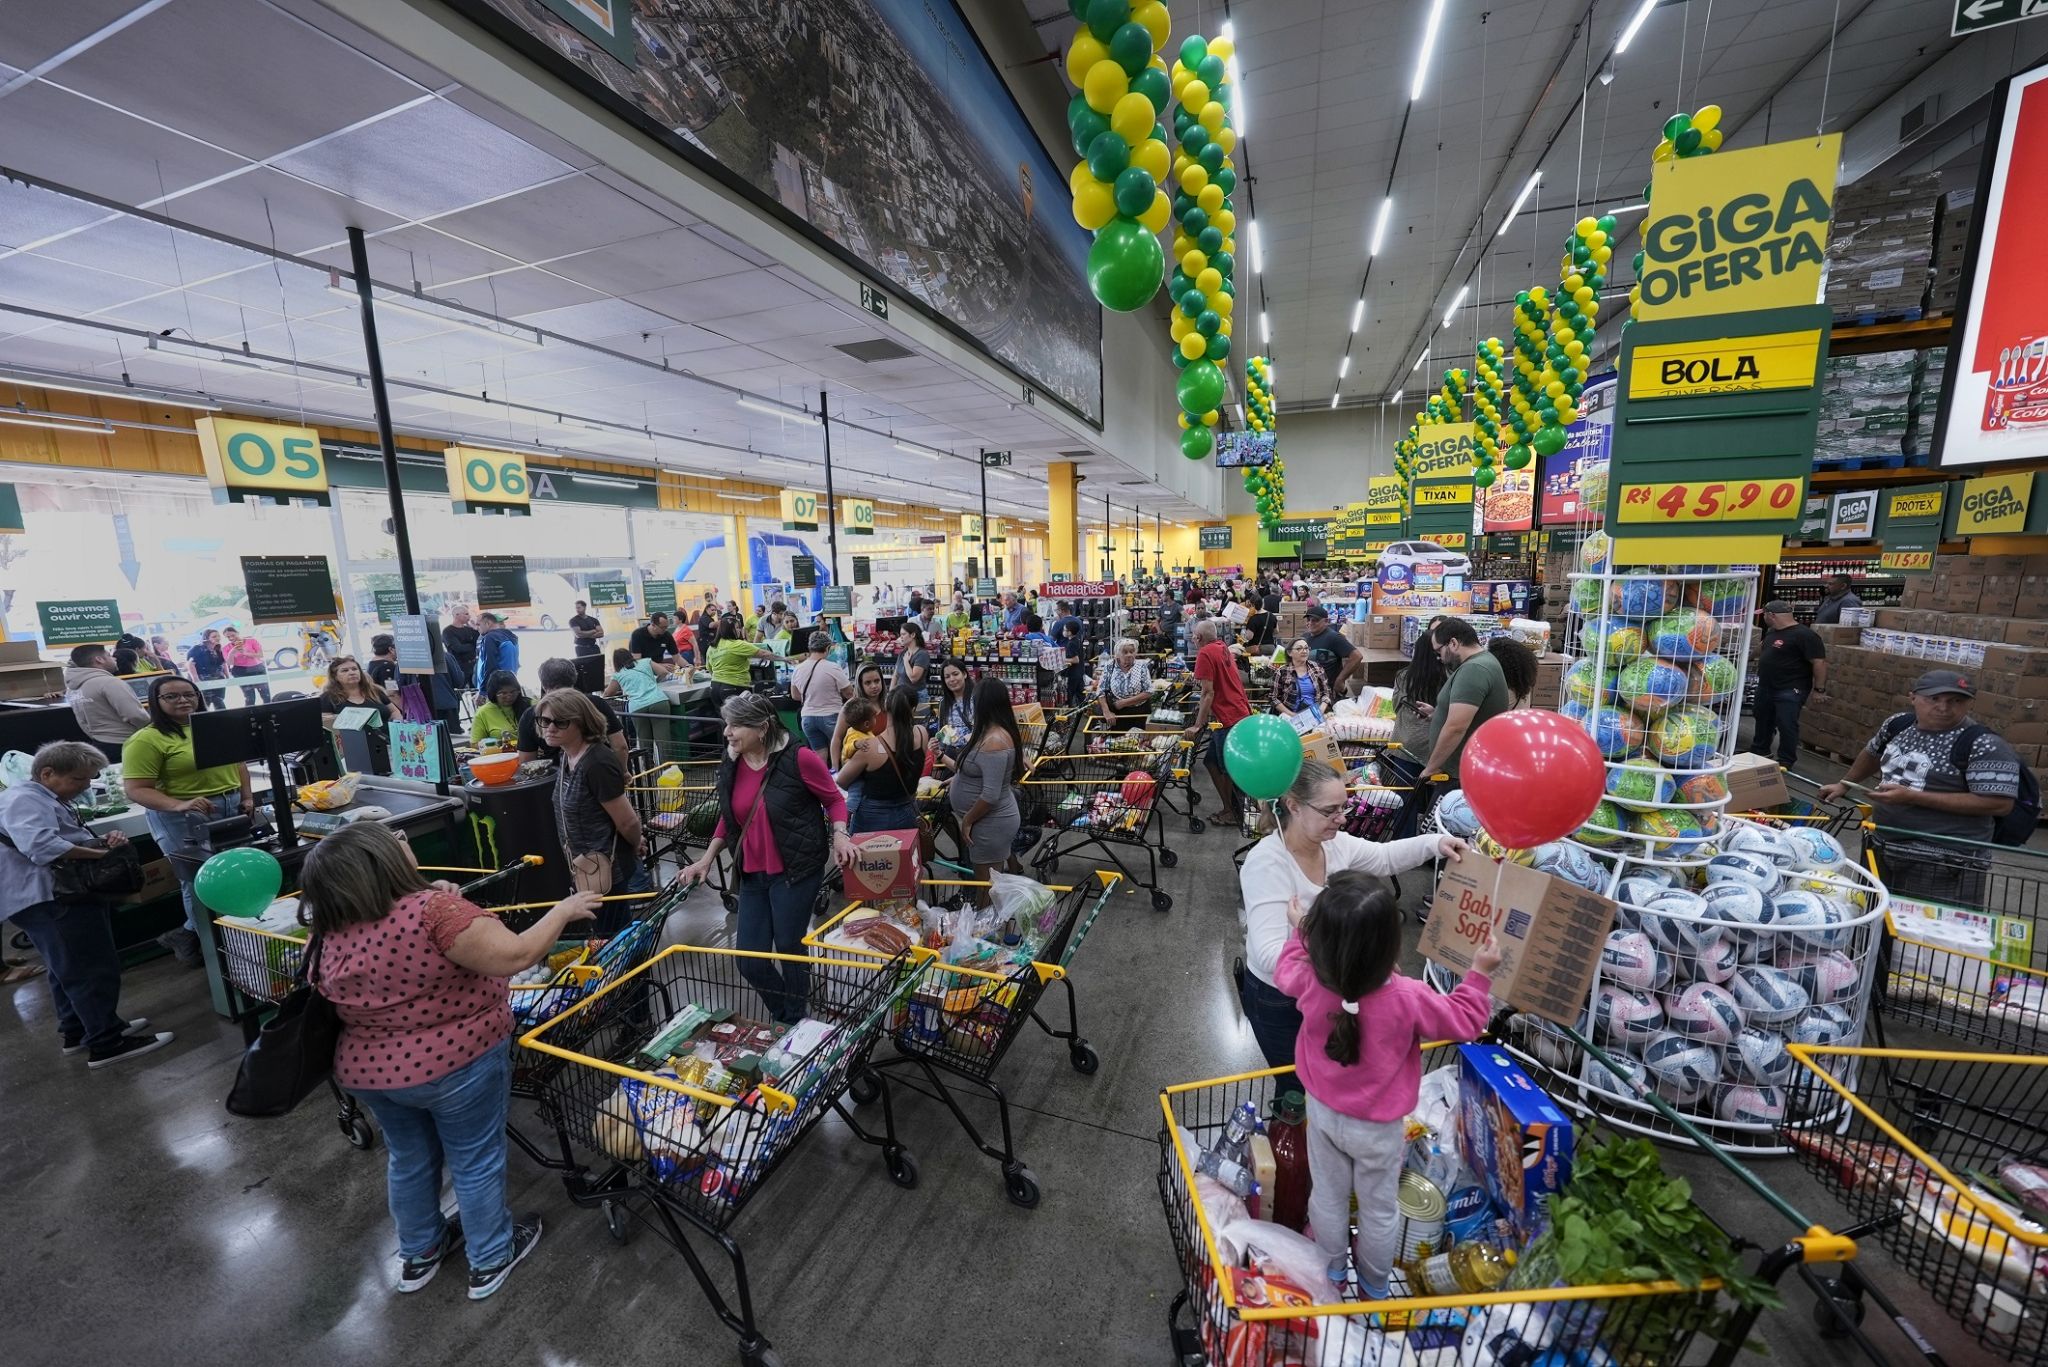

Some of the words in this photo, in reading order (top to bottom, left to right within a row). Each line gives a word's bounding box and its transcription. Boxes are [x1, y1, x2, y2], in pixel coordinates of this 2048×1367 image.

[1641, 231, 1823, 305] OFERTA
[1661, 355, 1760, 385] BOLA
[227, 433, 320, 479] 05
[1417, 452, 1472, 473] OFERTA
[466, 459, 526, 495] 06
[1368, 493, 1400, 506] OFERTA
[1424, 491, 1456, 501] TIXAN
[1625, 486, 1651, 504] R$
[795, 497, 816, 517] 07
[855, 505, 873, 522] 08
[1896, 499, 1934, 512] PROTEX
[1973, 500, 2024, 523] OFERTA
[971, 519, 981, 532] 09
[997, 523, 1005, 535] 10
[1307, 523, 1328, 533] SEÇÃ
[1046, 583, 1106, 596] havaianas
[48, 605, 110, 614] Queremos
[50, 613, 80, 621] ouvir
[83, 612, 111, 620] você
[1455, 913, 1491, 945] Soft
[1447, 1190, 1481, 1212] mil
